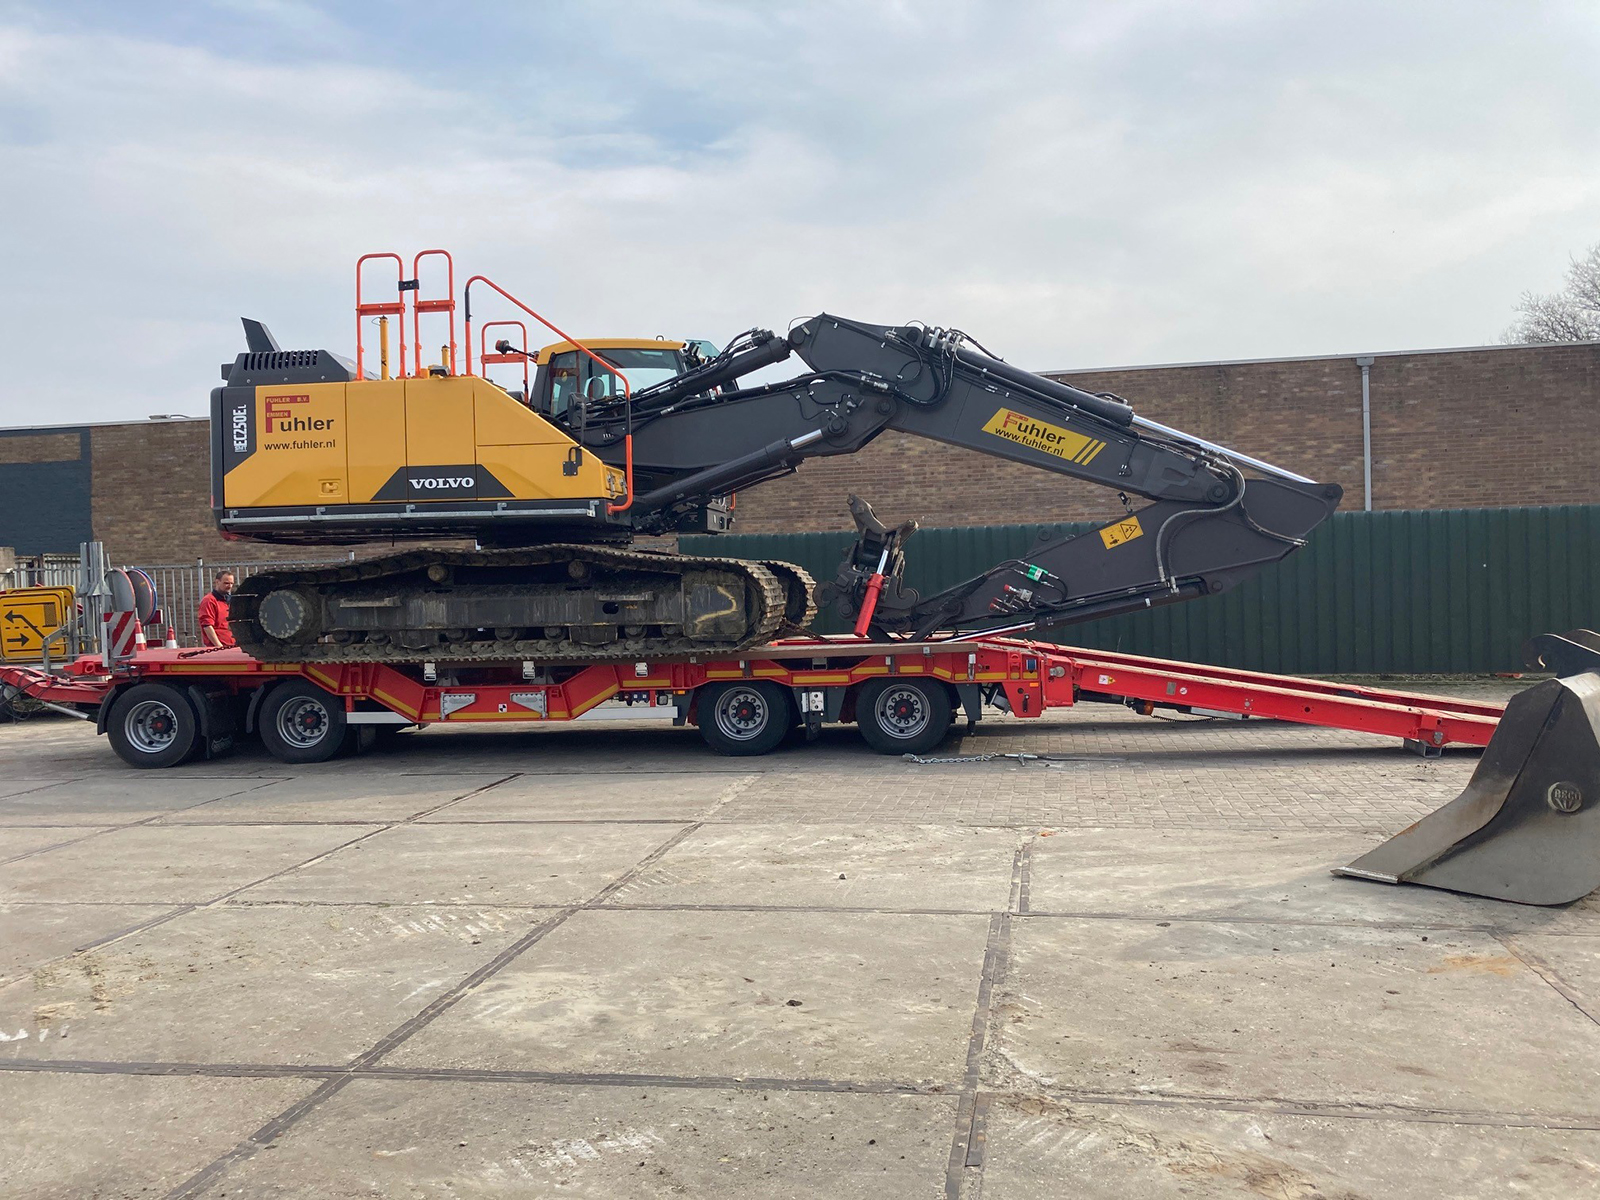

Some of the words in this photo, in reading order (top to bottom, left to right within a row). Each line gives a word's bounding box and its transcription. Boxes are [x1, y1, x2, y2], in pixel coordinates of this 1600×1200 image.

[265, 395, 335, 433] Fuhler
[1003, 411, 1066, 445] Fuhler
[264, 439, 336, 451] www.fuhler.nl
[995, 428, 1064, 456] www.fuhler.nl
[408, 477, 475, 489] VOLVO
